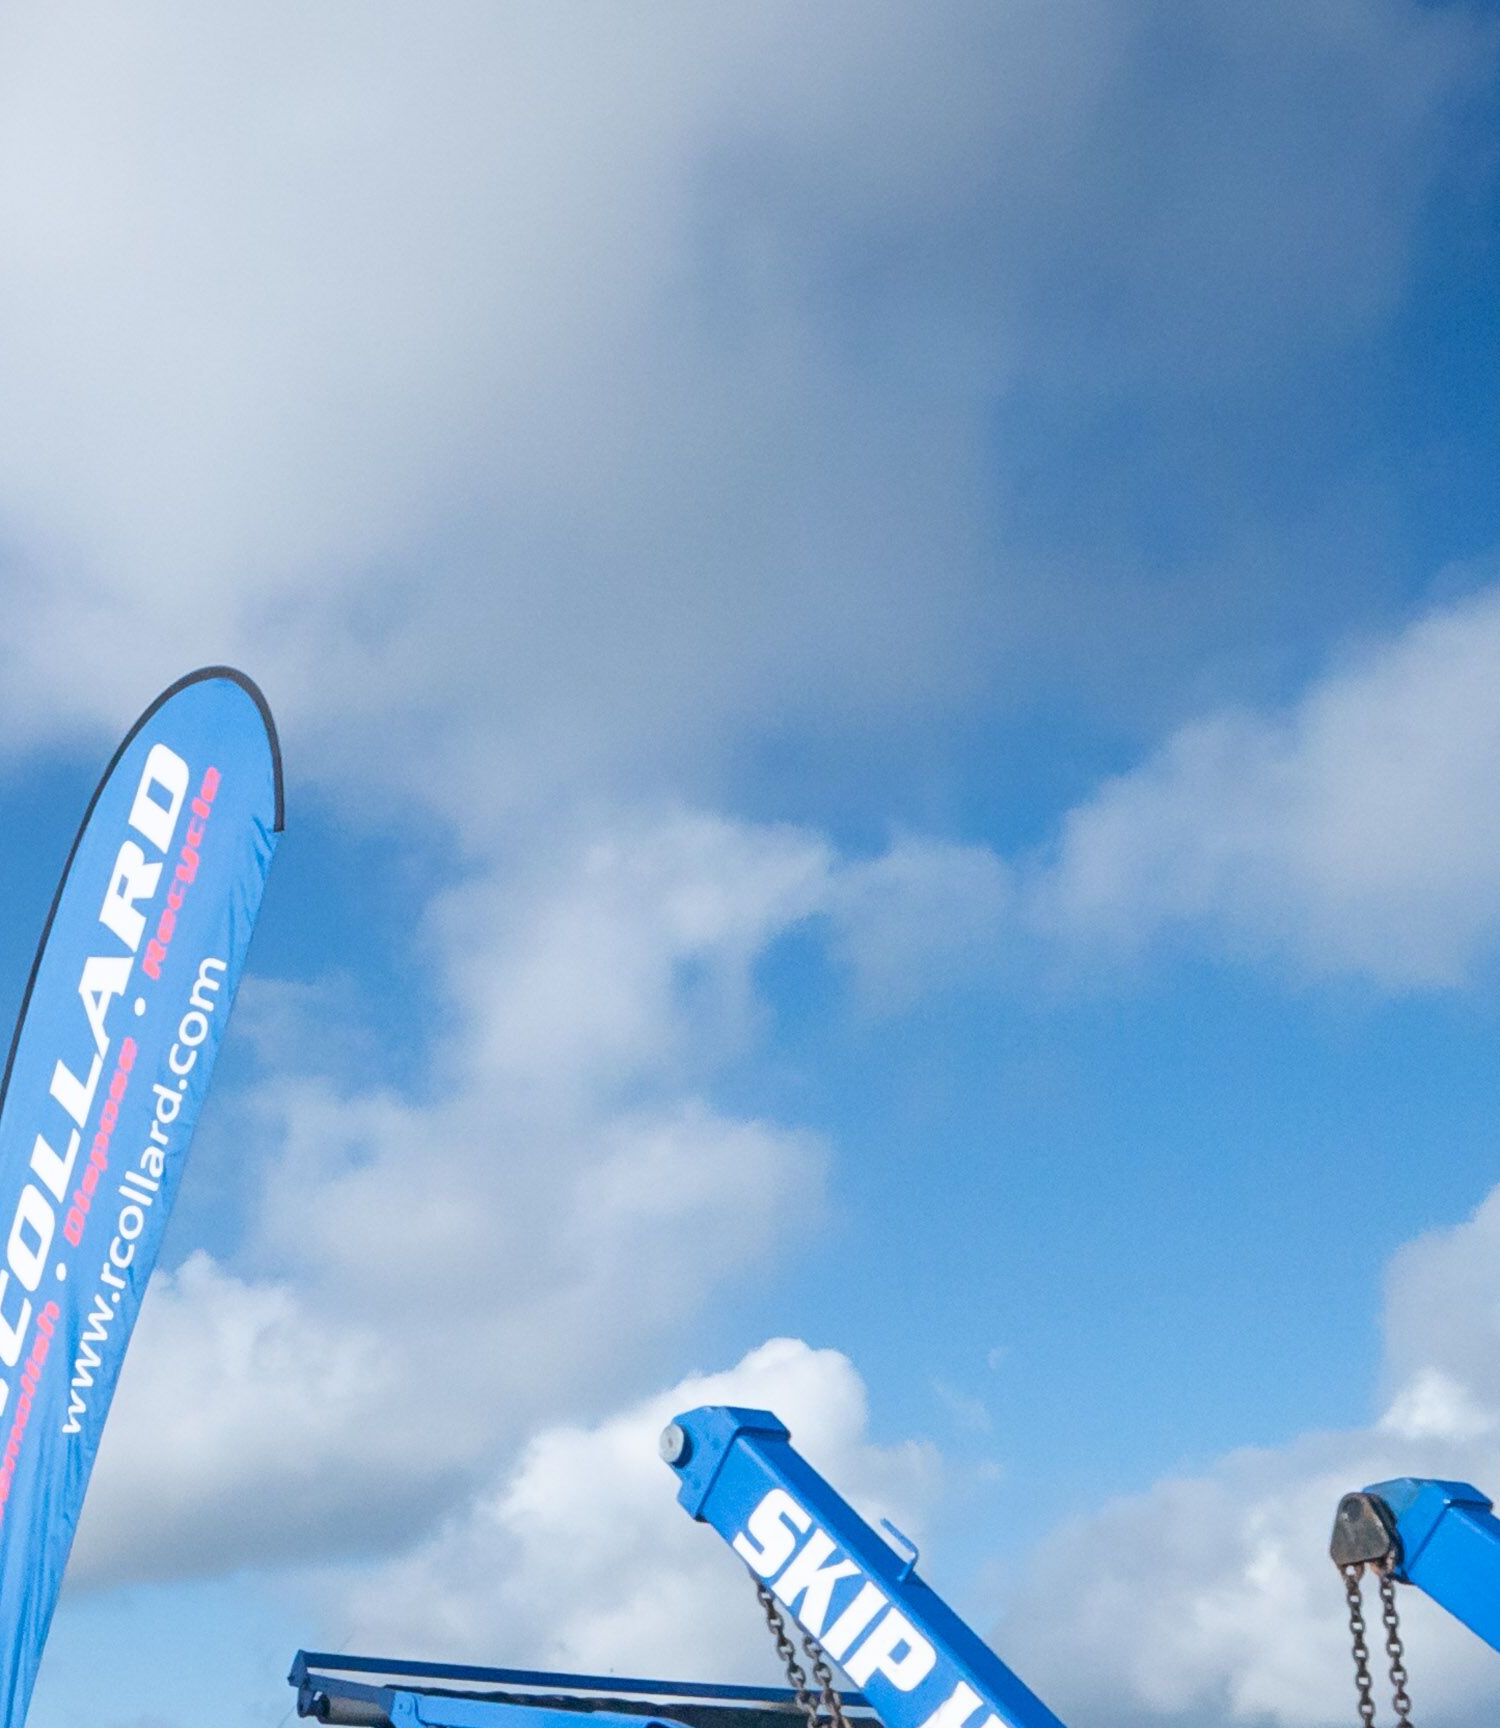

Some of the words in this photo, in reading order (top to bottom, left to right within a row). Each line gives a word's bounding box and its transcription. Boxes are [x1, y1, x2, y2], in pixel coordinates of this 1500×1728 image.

[62, 1037, 138, 1248] Dispose
[142, 766, 222, 980] Recycle
[62, 956, 228, 1434] www.rcollard.com
[732, 1488, 937, 1691] SKIP
